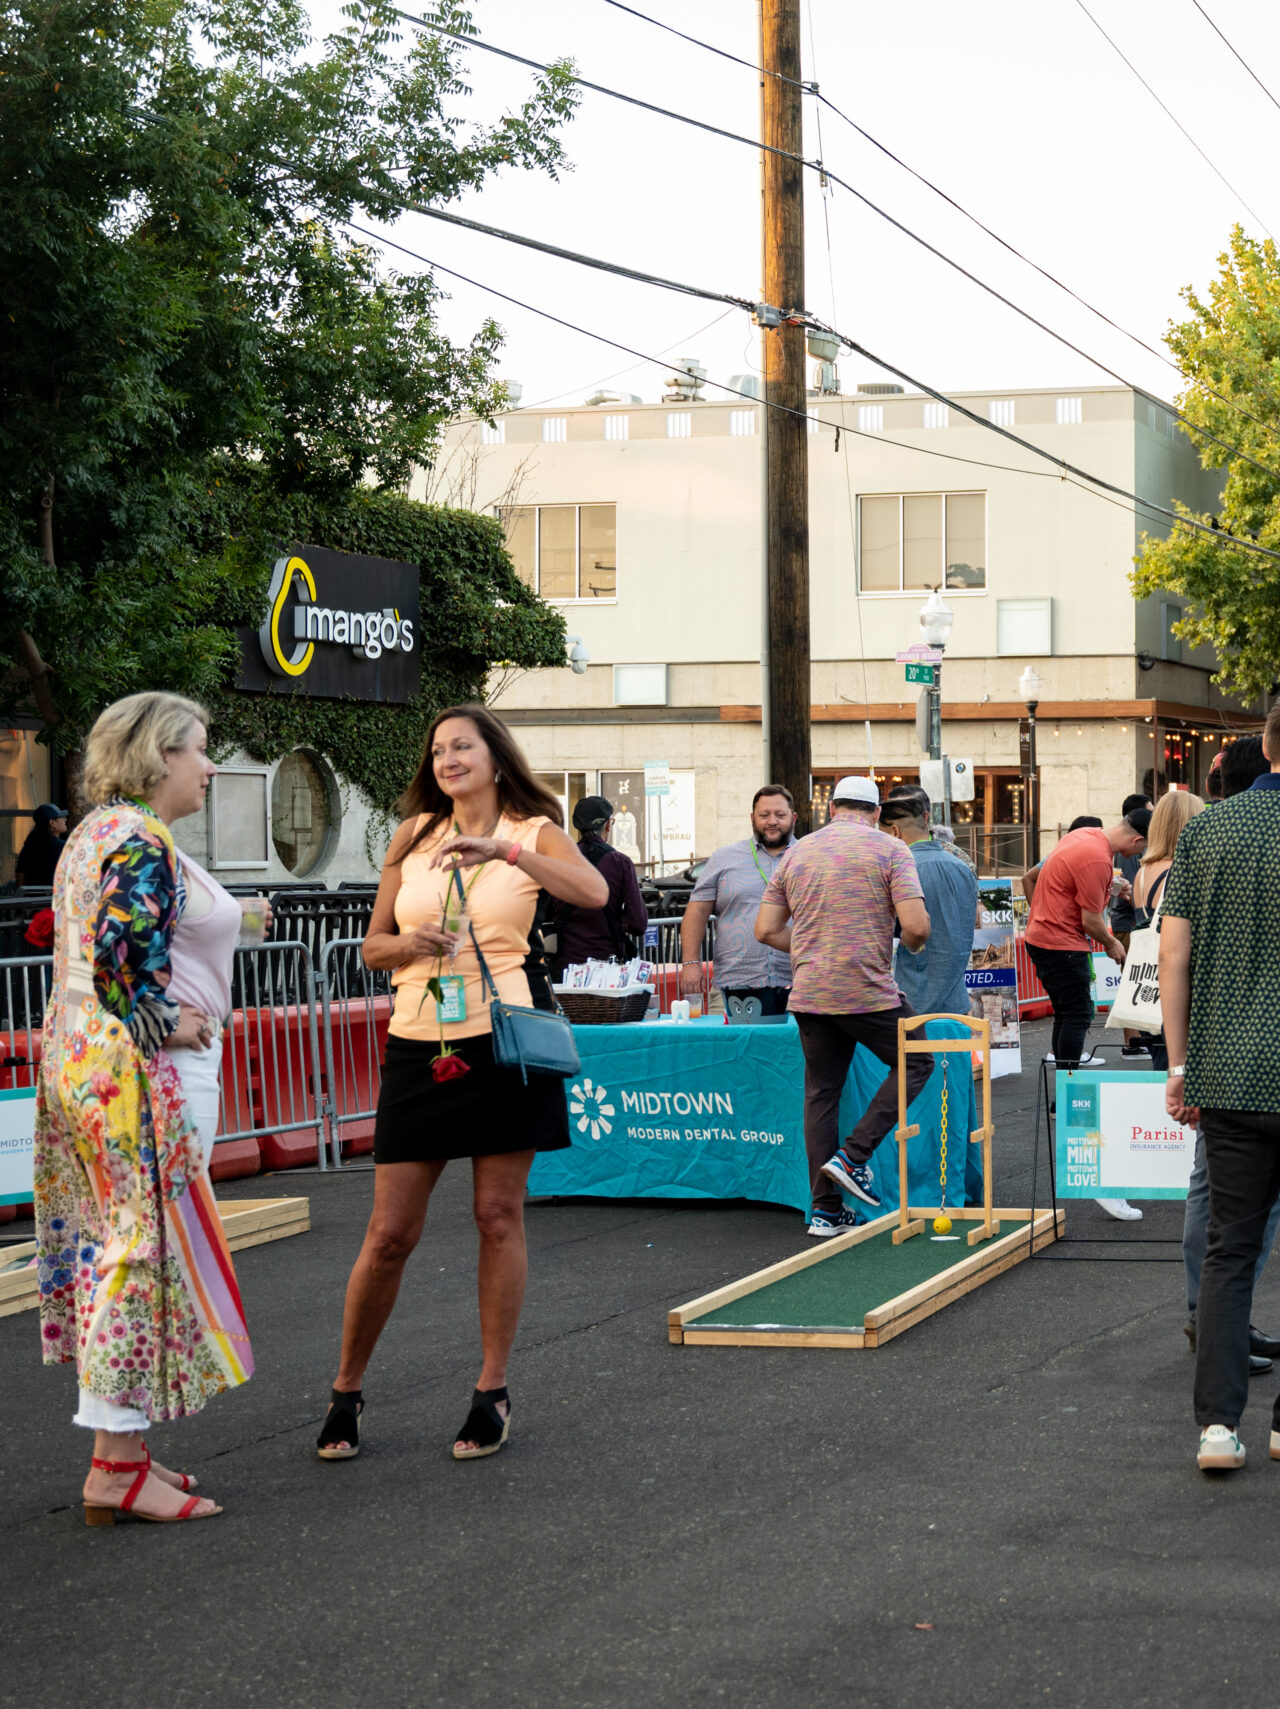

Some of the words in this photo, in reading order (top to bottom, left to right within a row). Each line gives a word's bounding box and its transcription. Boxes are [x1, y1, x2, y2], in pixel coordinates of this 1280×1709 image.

[306, 606, 414, 659] mango's
[653, 833, 691, 841] LWBRAU
[982, 910, 1013, 923] SKK
[620, 1090, 734, 1115] MIDTOWN
[1072, 1099, 1091, 1108] SKK
[627, 1127, 681, 1141] MODERN
[684, 1128, 737, 1141] DENTAL
[740, 1129, 785, 1145] GROUP
[1131, 1126, 1184, 1141] Parisi
[1129, 1143, 1161, 1151] INSURANCE
[1163, 1143, 1186, 1151] AGENCY
[1067, 1146, 1098, 1164] MINI
[1067, 1173, 1098, 1187] LOVE
